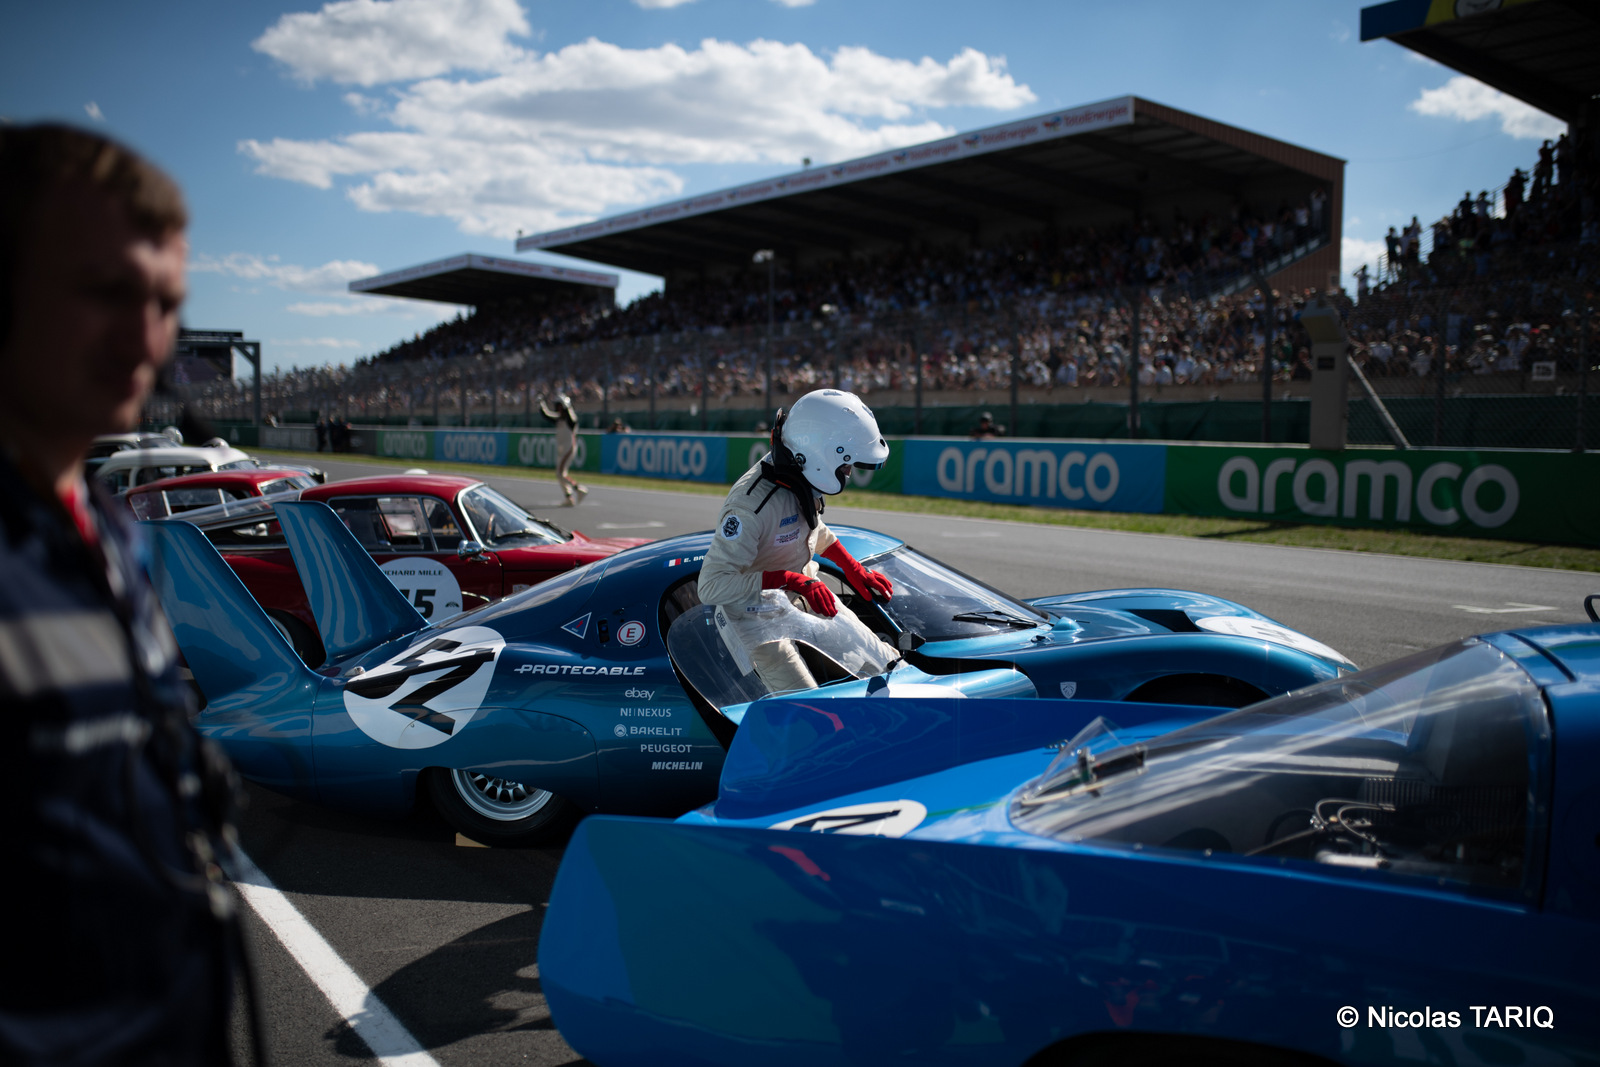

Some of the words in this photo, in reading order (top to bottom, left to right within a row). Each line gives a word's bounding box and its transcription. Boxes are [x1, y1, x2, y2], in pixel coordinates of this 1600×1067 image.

[1063, 105, 1128, 127] TotalEnergies
[383, 433, 427, 458] aramco
[443, 434, 497, 461] aramco
[617, 438, 707, 477] aramco
[937, 447, 1120, 501] aramco
[1217, 456, 1519, 528] aramco
[400, 589, 436, 619] 5
[626, 627, 636, 638] E
[514, 664, 646, 676] PROTECABLE
[624, 687, 655, 700] ebay
[637, 708, 672, 718] NEXUS
[630, 726, 682, 736] BAKELIT
[640, 744, 692, 753] PEUGEOT
[652, 762, 703, 770] MICHELIN
